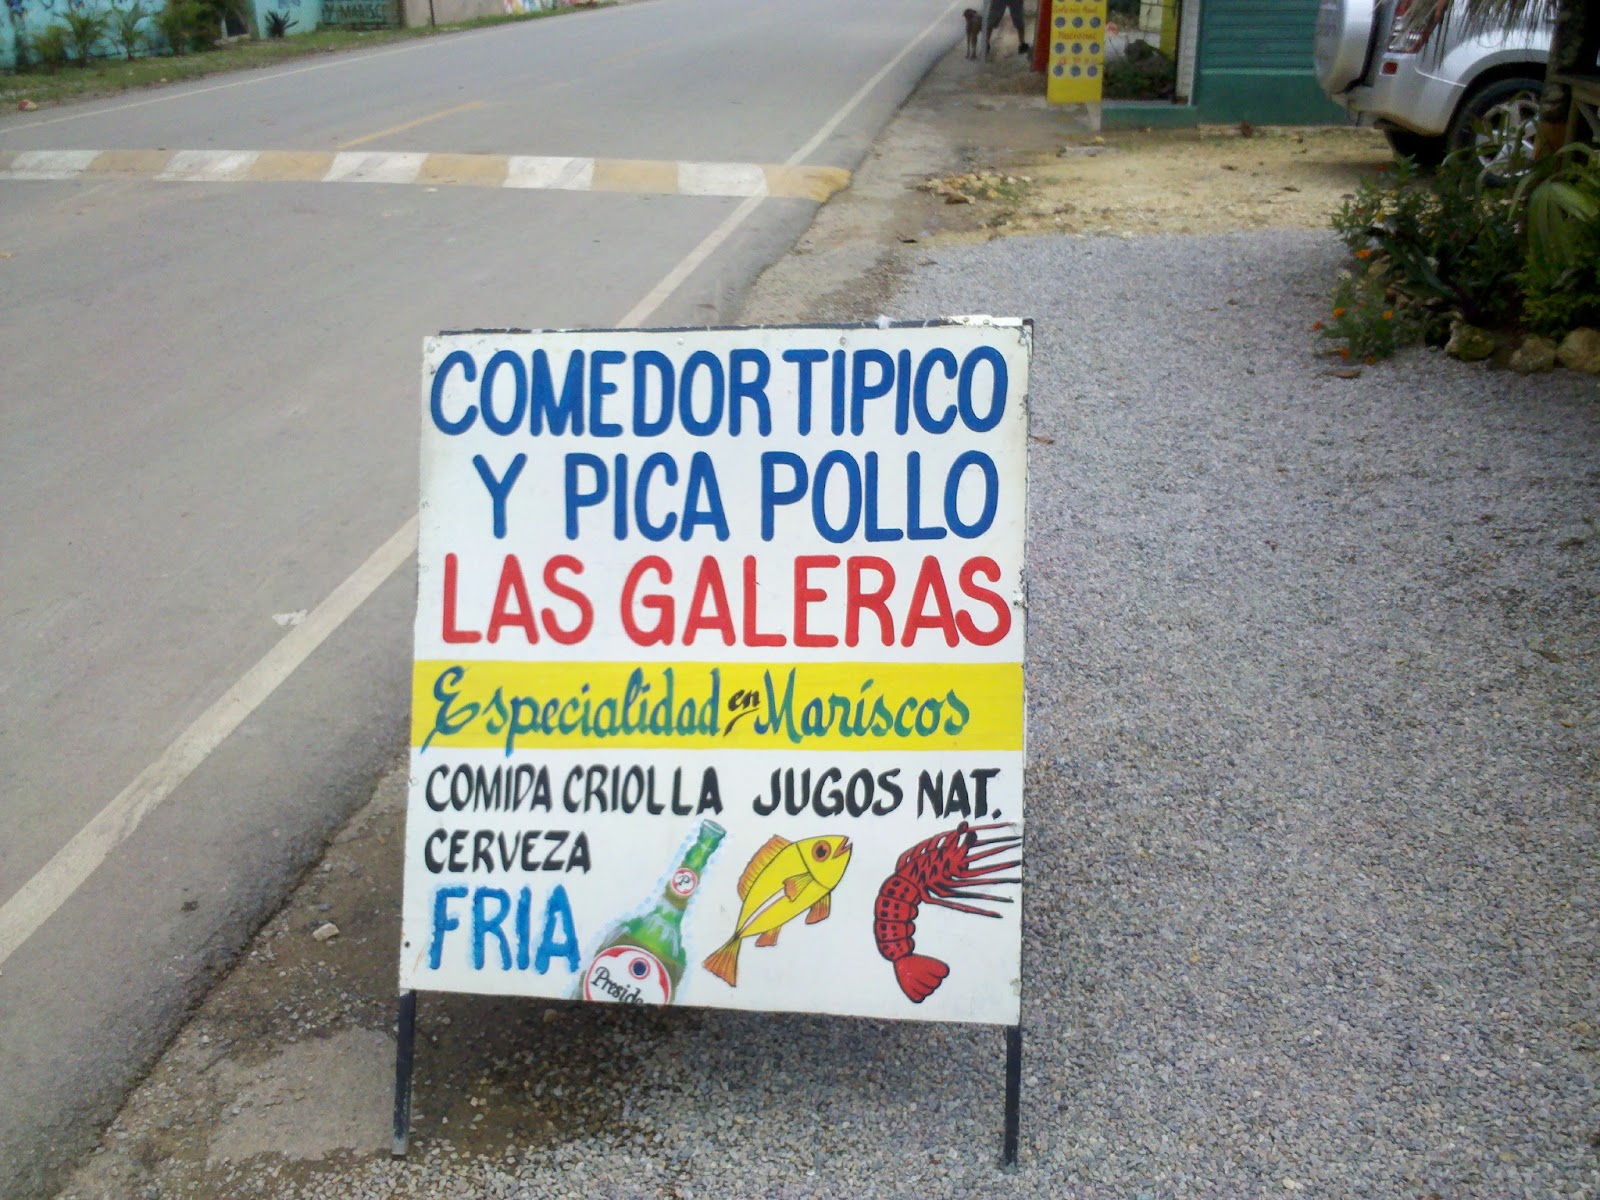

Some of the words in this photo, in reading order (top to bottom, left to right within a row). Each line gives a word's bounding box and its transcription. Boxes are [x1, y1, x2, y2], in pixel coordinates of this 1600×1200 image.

[430, 348, 772, 438] COMEDOR
[782, 346, 1009, 436] TIPICO
[472, 453, 527, 540] Y
[564, 452, 730, 542] PICA
[761, 450, 1000, 544] POLLO
[442, 553, 595, 646] LAS
[621, 555, 1012, 648] GALERAS
[420, 665, 720, 758] Especialidad
[723, 689, 760, 728] en
[425, 763, 550, 814] COMIDA
[563, 764, 724, 817] CRIOLLA
[753, 767, 904, 818] JUGOS
[917, 768, 1003, 820] NAT.
[424, 828, 592, 875] CERVEZA
[429, 883, 581, 974] FRIA
